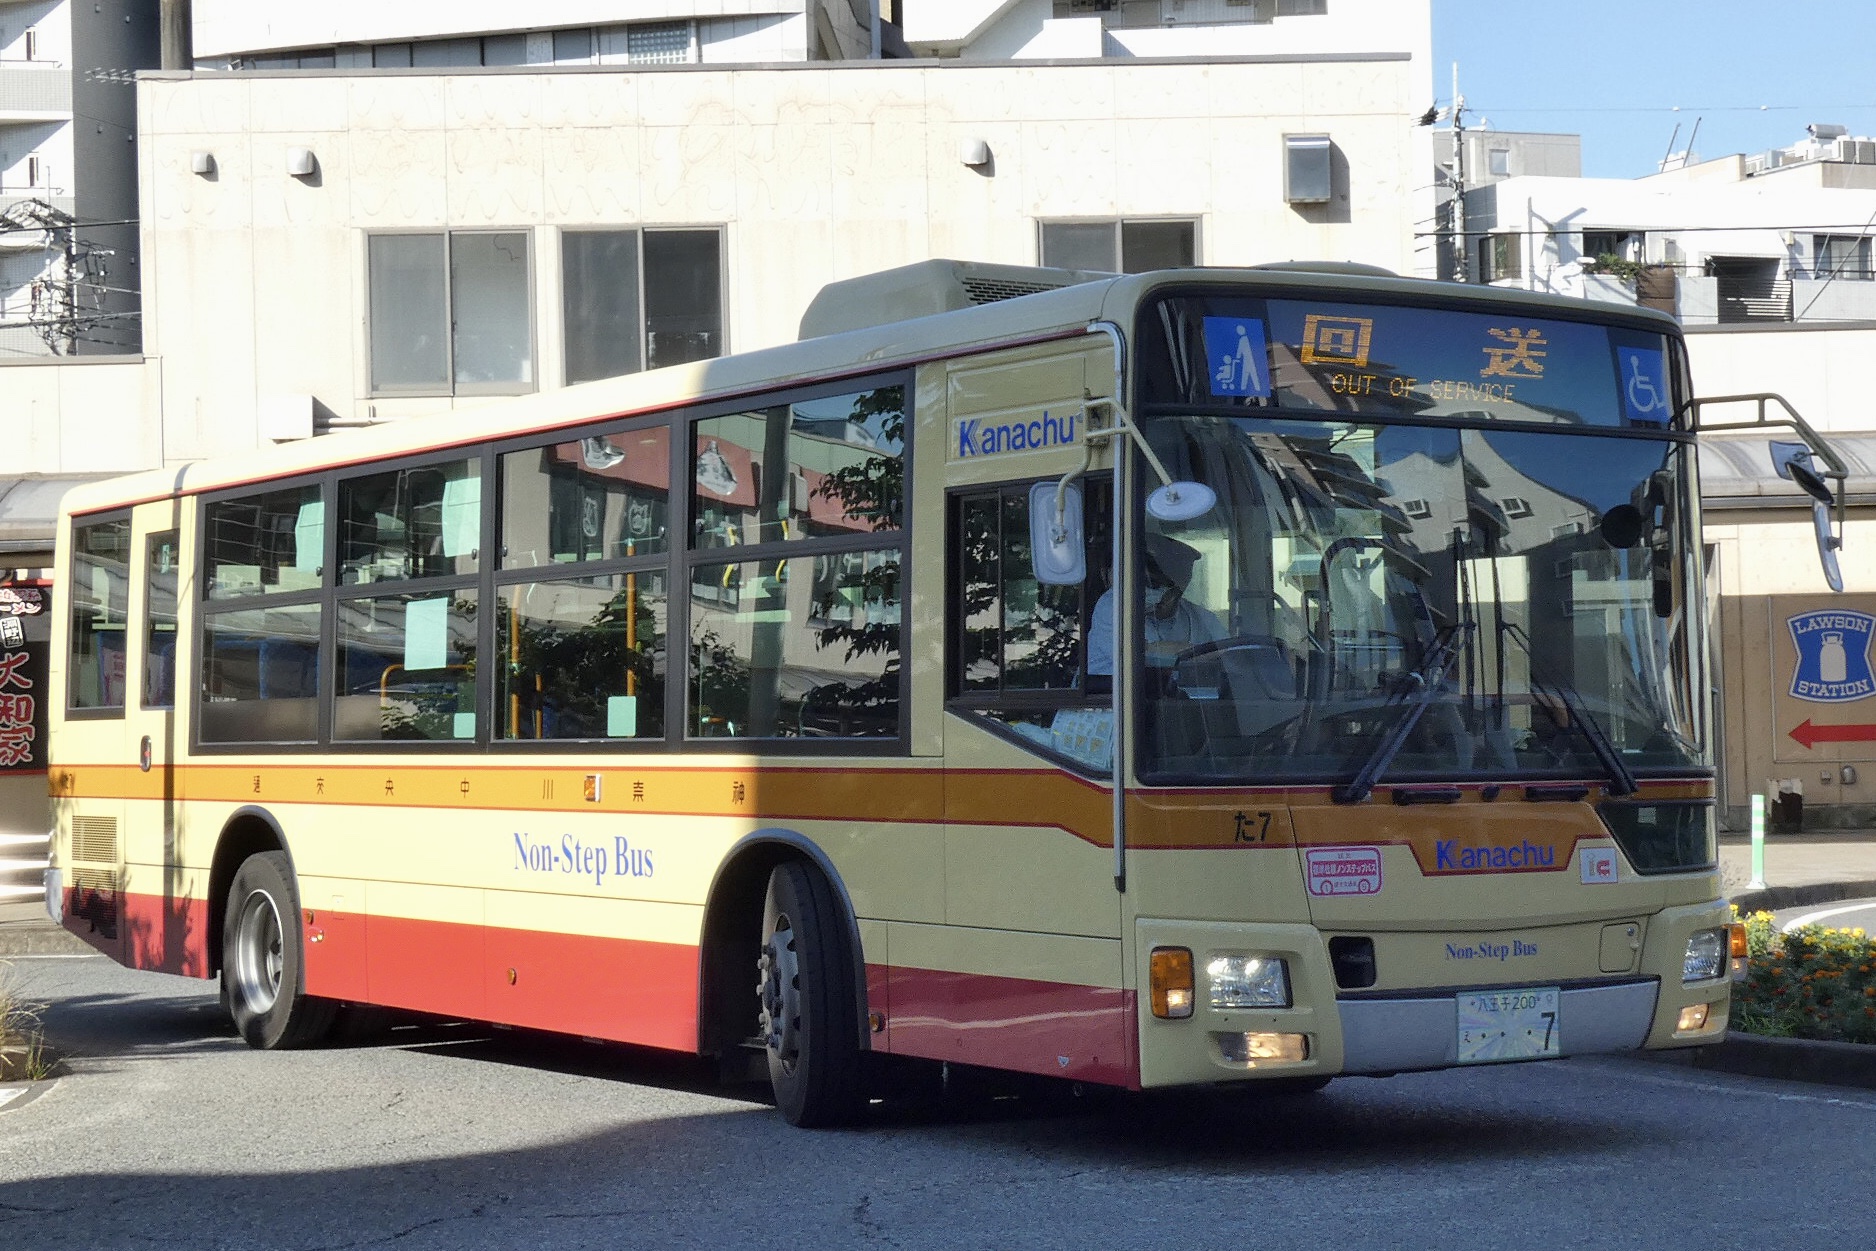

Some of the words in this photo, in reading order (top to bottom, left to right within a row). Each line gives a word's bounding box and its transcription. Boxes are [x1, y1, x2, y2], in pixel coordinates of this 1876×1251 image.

[1332, 373, 1376, 395] OUT
[1389, 377, 1417, 398] OF
[1430, 380, 1517, 403] SERVICE
[960, 410, 1075, 457] Kanachu
[1795, 616, 1869, 634] LAWSON
[1798, 679, 1870, 697] STATION
[1234, 811, 1271, 842] た7
[514, 832, 608, 886] Non-Step
[614, 836, 654, 878] Bus
[1436, 839, 1555, 870] Kanachu
[1446, 941, 1509, 961] Non-Step
[1513, 940, 1538, 957] Bus
